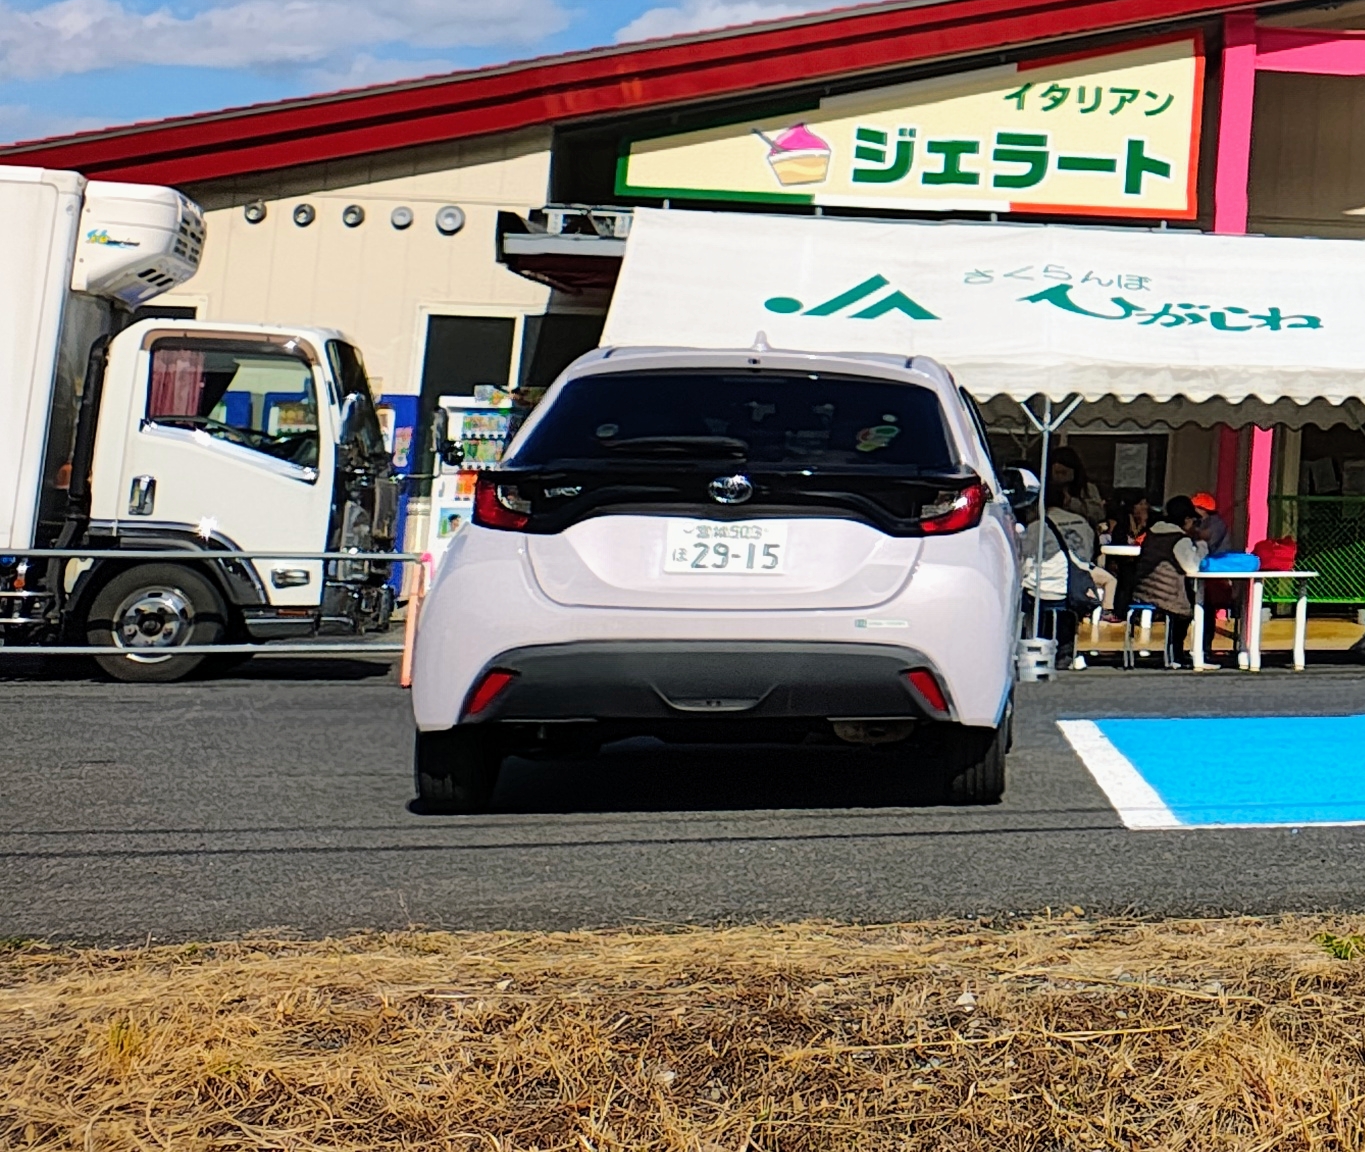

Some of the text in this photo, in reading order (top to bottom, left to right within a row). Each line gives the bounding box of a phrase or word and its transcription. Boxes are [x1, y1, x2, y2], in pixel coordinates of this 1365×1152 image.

[1003, 81, 1175, 117] イタリアン
[852, 126, 1172, 195] ジェラート
[964, 264, 1153, 291] さくらんぼ
[690, 542, 781, 570] 29-15
